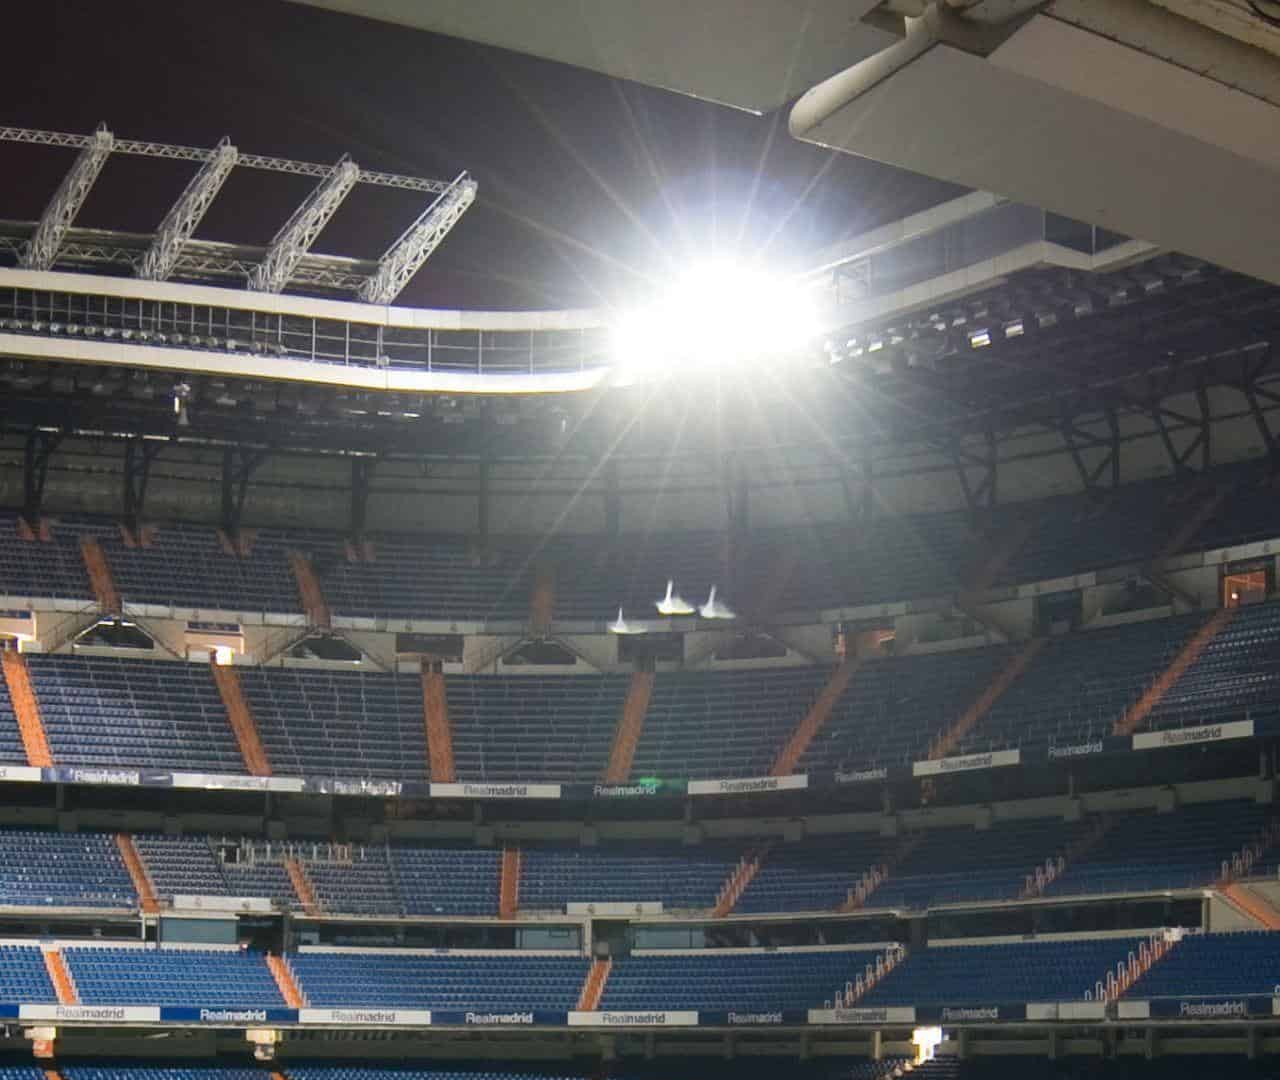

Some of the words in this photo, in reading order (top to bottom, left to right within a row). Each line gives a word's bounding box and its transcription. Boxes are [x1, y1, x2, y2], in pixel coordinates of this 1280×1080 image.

[1162, 727, 1221, 744] Realmadrid
[463, 784, 527, 797] Realmadrid
[593, 783, 656, 795] Realmadrid
[55, 1007, 126, 1020] Realmadrid
[200, 1009, 267, 1022] Realmadrid
[330, 1010, 396, 1023] Realmadrid
[465, 1012, 534, 1024] Realmadrid
[602, 1012, 666, 1025] Realmadrid
[727, 1012, 782, 1024] Realmadrid
